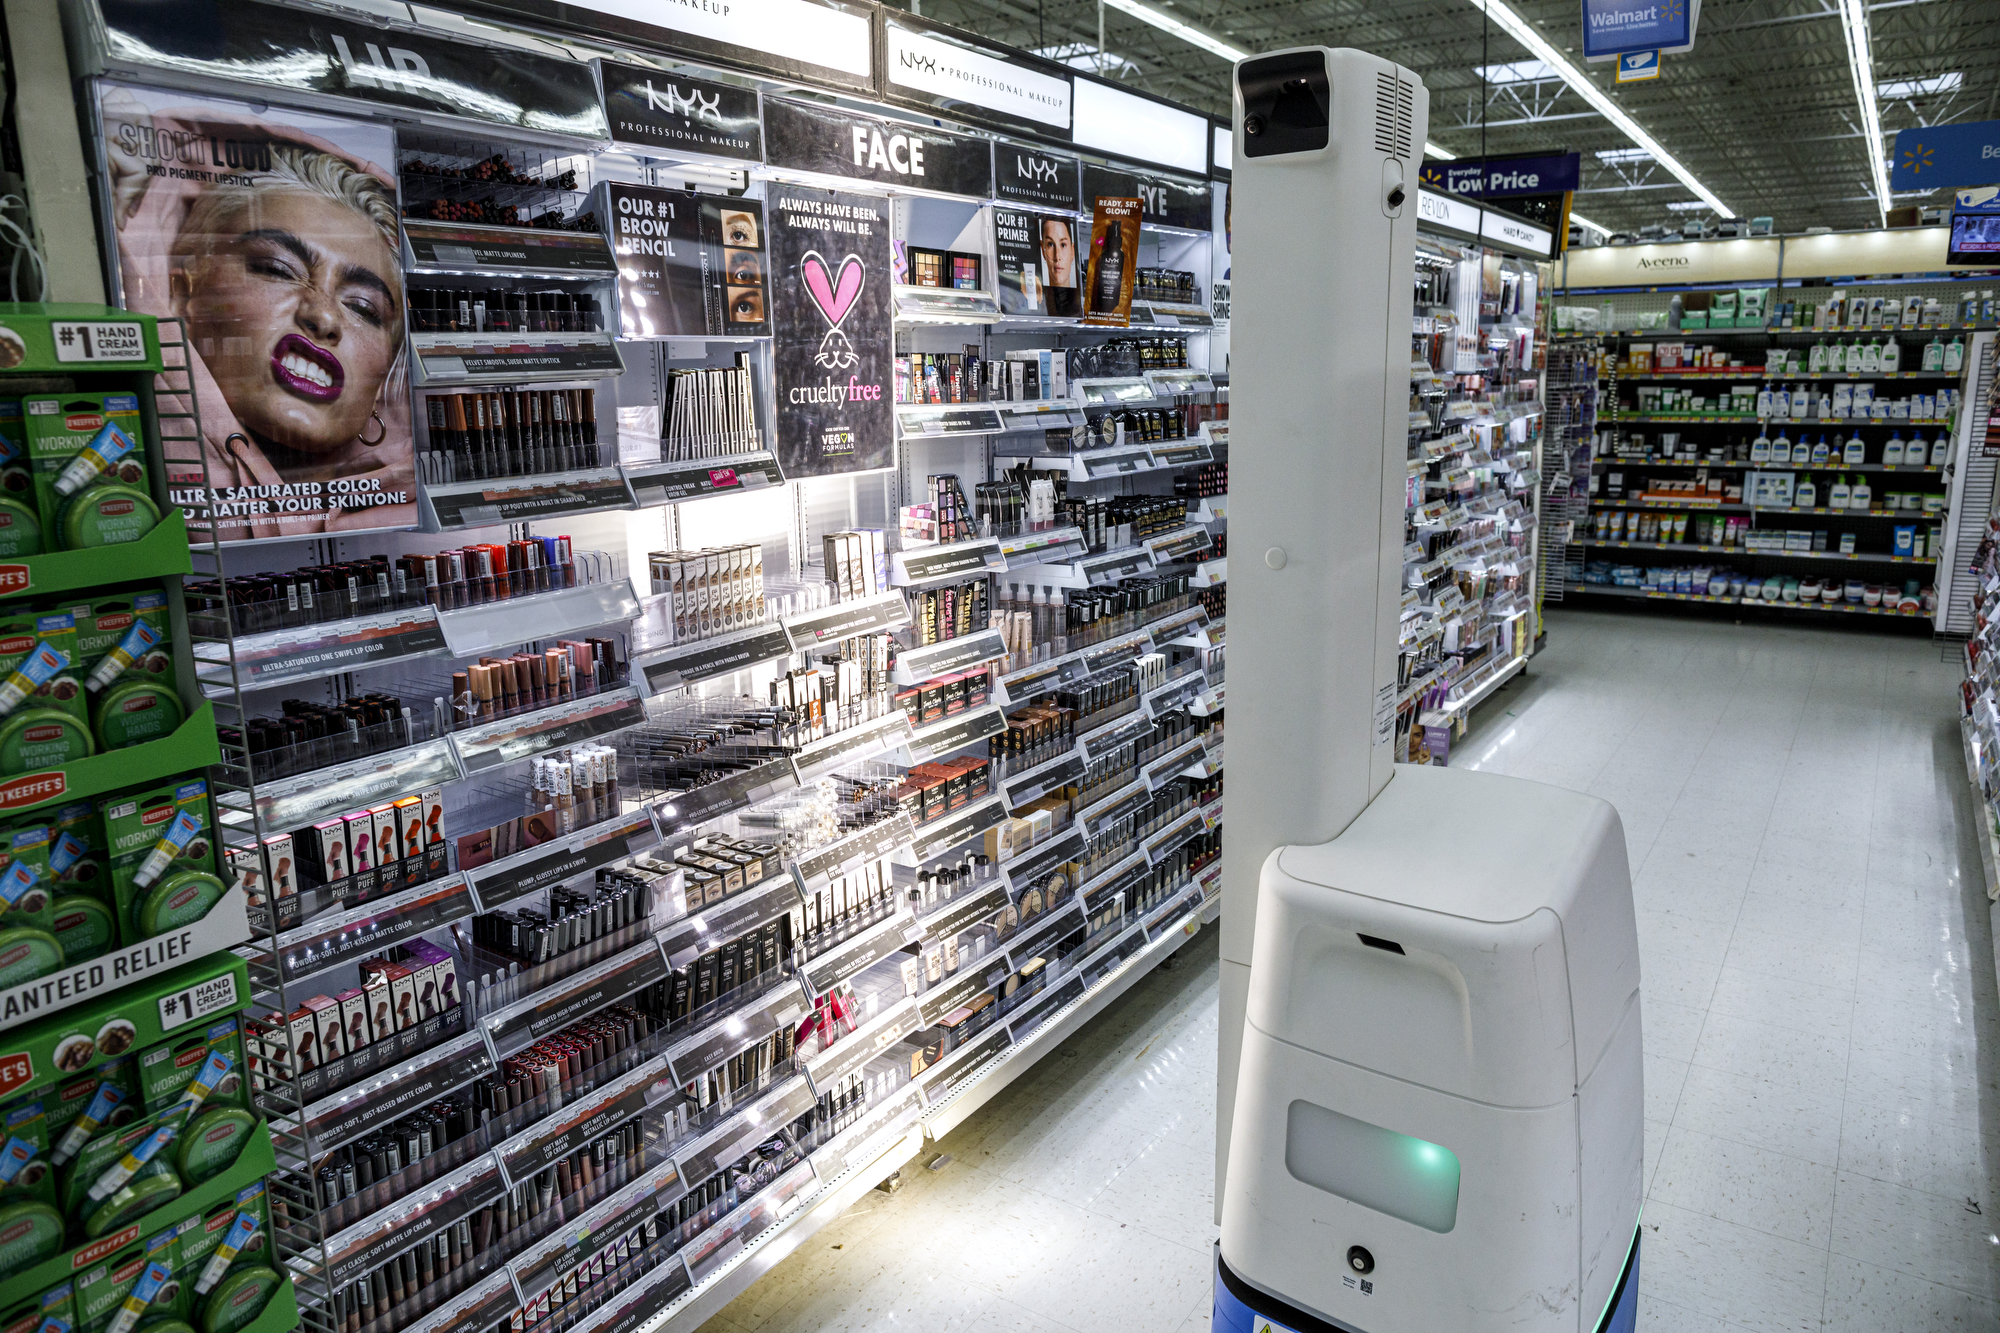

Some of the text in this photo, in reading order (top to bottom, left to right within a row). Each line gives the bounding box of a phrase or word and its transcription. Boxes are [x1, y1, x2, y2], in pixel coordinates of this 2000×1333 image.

[1590, 5, 1657, 27] Walmart
[330, 34, 432, 95] LIP
[901, 49, 1063, 108] NYX PROFESSIONAL MAKEUP
[647, 80, 722, 122] NYX
[620, 121, 750, 149] PROFESSIONAL MAKEUP
[119, 123, 273, 173] SHOUT LOUD
[852, 126, 925, 177] FACE
[146, 164, 255, 188] PRO PIGMENT LIPSTICK
[1017, 155, 1058, 184] NYX
[1448, 168, 1481, 177] Everyday
[1448, 171, 1539, 193] Low Price
[1002, 185, 1073, 202] PROFESSIONAL MAKEUP
[618, 197, 675, 219] OUR #1
[779, 198, 880, 222] ALWAYS HAVE BEEN.
[1099, 200, 1139, 209] READY, SET,
[1421, 196, 1450, 221] REVLON
[620, 217, 669, 237] BROW
[789, 215, 873, 235] ALWAYS WILL BE.
[997, 212, 1027, 228] OUR #1
[998, 226, 1029, 243] PRIMER
[483, 250, 501, 258] MATTE
[501, 251, 526, 259] LIPLINERS
[622, 237, 676, 257] PENCIL
[1637, 257, 1688, 269] Aveeno
[1213, 302, 1230, 319] SHINE
[97, 327, 136, 338] HAND
[59, 326, 94, 358] #1
[97, 339, 139, 349] CREAM
[525, 357, 539, 365] MATTE
[540, 357, 561, 365] LIPSTICK
[67, 418, 102, 428] O'KEEFFE'S
[823, 443, 854, 451] FORMULAS
[226, 482, 322, 500] SATURATED
[327, 478, 381, 494] COLOR
[666, 484, 683, 492] CONTROL
[274, 497, 326, 513] YOUR
[328, 491, 407, 509] SKINTONE
[510, 502, 524, 510] POUT
[97, 516, 142, 531] WORKING
[218, 520, 236, 529] SATIN
[238, 519, 258, 528] FINISH
[281, 515, 307, 524] BUILT-IN
[308, 513, 330, 523] PRIMER
[103, 529, 139, 543] HANDS
[262, 643, 384, 672] ULTRA-SATURATED ONE SWIPE LIP COLOR
[121, 710, 164, 727] WORKING
[126, 722, 161, 737] HANDS
[19, 741, 69, 758] WORKING
[370, 784, 379, 793] LIP
[380, 779, 400, 791] COLOR
[424, 791, 440, 800] NYX
[376, 811, 393, 820] NYX
[404, 805, 420, 814] NYX
[352, 818, 369, 828] NYX
[429, 848, 445, 859] PUFF
[382, 870, 399, 881] PUFF
[407, 862, 423, 873] PUFF
[518, 877, 536, 889] PLUMP,
[536, 870, 553, 882] GLOSSY
[552, 866, 564, 876] LIPS
[573, 857, 587, 867] SWIPE
[339, 935, 375, 955] JUST-KISSED
[375, 928, 394, 941] MATTE
[394, 920, 413, 933] COLOR
[0, 931, 191, 1022] ANTEED RELIEF
[196, 978, 230, 998] HAND
[164, 993, 193, 1020] #1
[197, 988, 232, 1007] CREAM
[531, 1013, 557, 1031] PIGMENTED
[557, 1002, 582, 1018] HIGH-SHINE
[588, 991, 603, 1003] COLOR
[703, 1051, 713, 1062] EASY
[362, 1100, 396, 1121] JUST-KISSED
[396, 1090, 414, 1105] MATTE
[415, 1082, 433, 1096] COLOR
[581, 1113, 607, 1131] SOFT MATTE
[583, 1122, 604, 1138] METALLIC
[610, 1110, 625, 1122] CREAM
[543, 1134, 570, 1153] SOFT MATTE
[545, 1142, 569, 1159] LIP CREAM
[592, 1221, 625, 1244] COLOR-SHIFTING
[631, 1206, 643, 1219] GLOSS
[76, 1228, 140, 1263] O'KEEFFE'S
[333, 1218, 431, 1277] CULT CLASSIC SOFT MATTE LIP CREAM
[561, 1246, 581, 1263] LINGERIE
[556, 1257, 576, 1273] LIPSTICK
